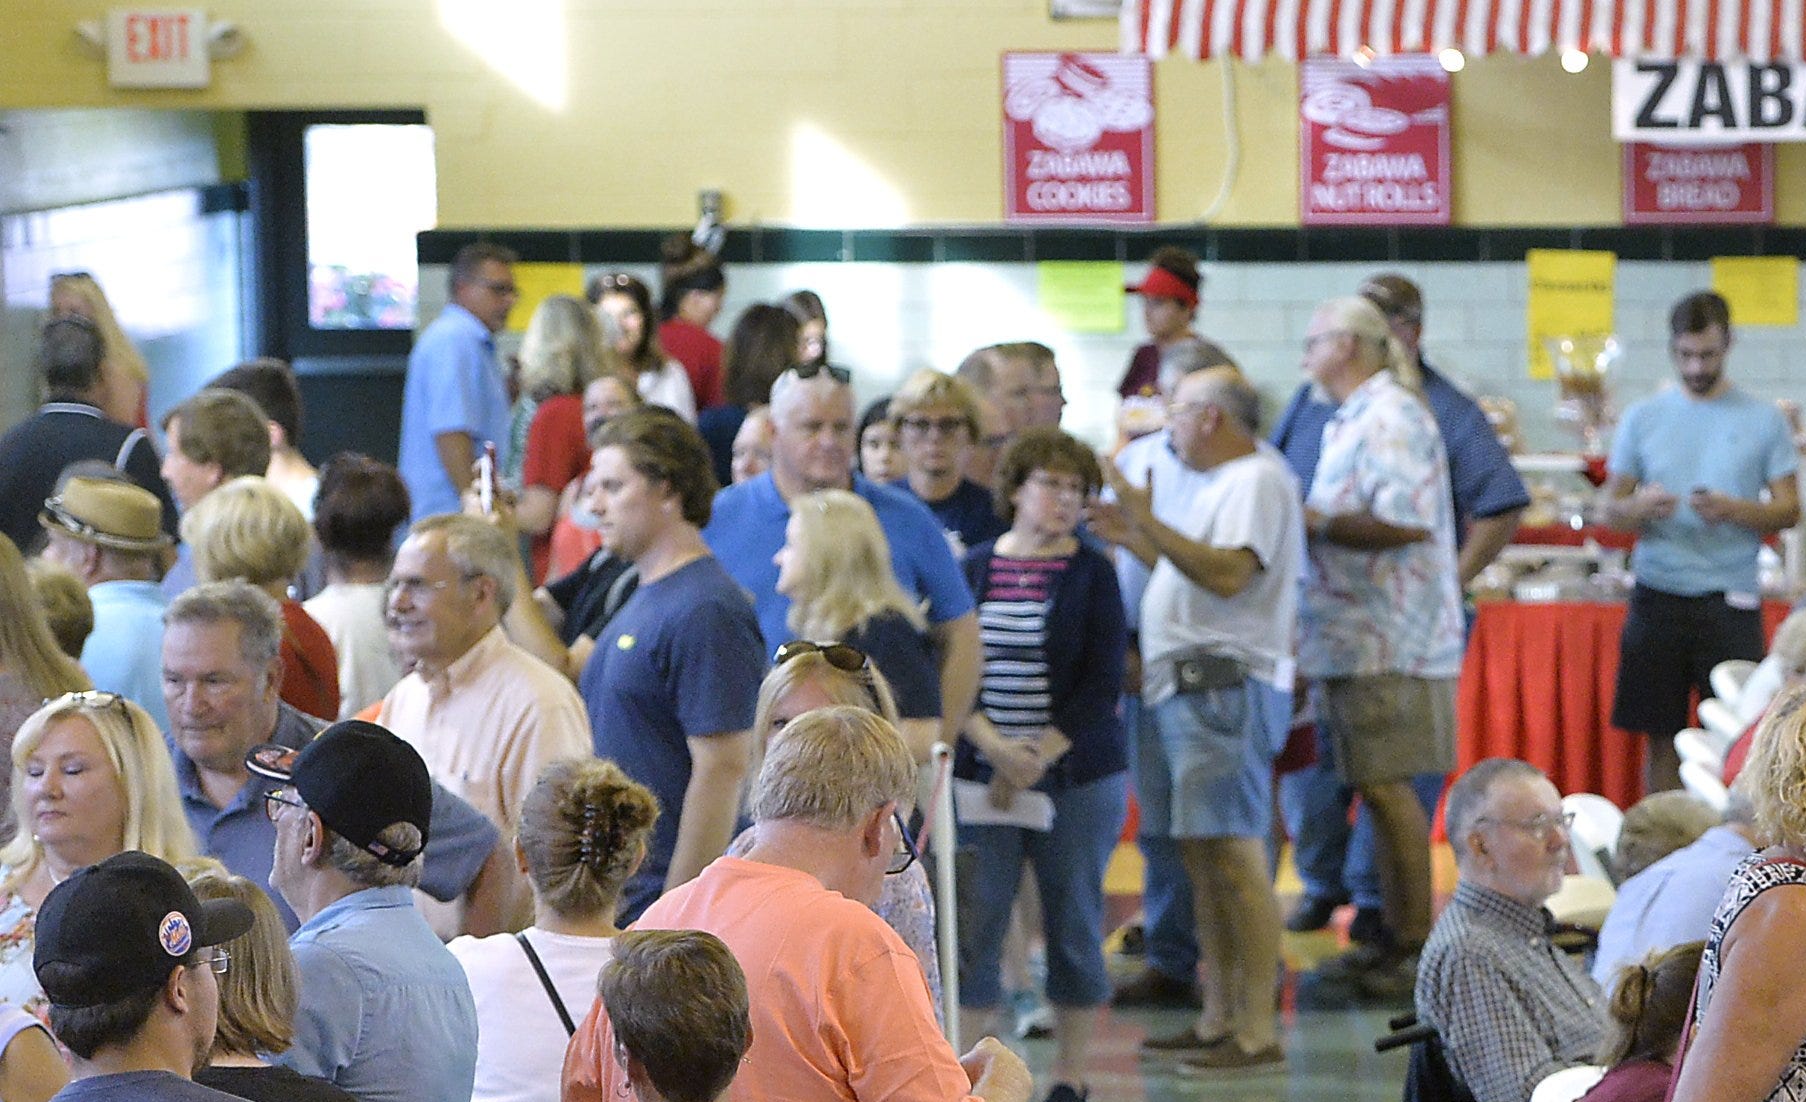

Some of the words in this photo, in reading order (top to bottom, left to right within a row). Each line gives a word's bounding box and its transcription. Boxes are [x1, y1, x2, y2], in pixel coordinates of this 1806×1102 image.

[126, 13, 190, 63] EXIT
[1025, 150, 1132, 180] ZABAWA
[1322, 153, 1428, 182] ZABAWA
[1644, 152, 1750, 181] ZABAWA
[1025, 180, 1132, 211] COOKIES
[1312, 182, 1361, 211] NUT
[1363, 182, 1438, 211] ROLLS
[1656, 181, 1742, 210] BREAD
